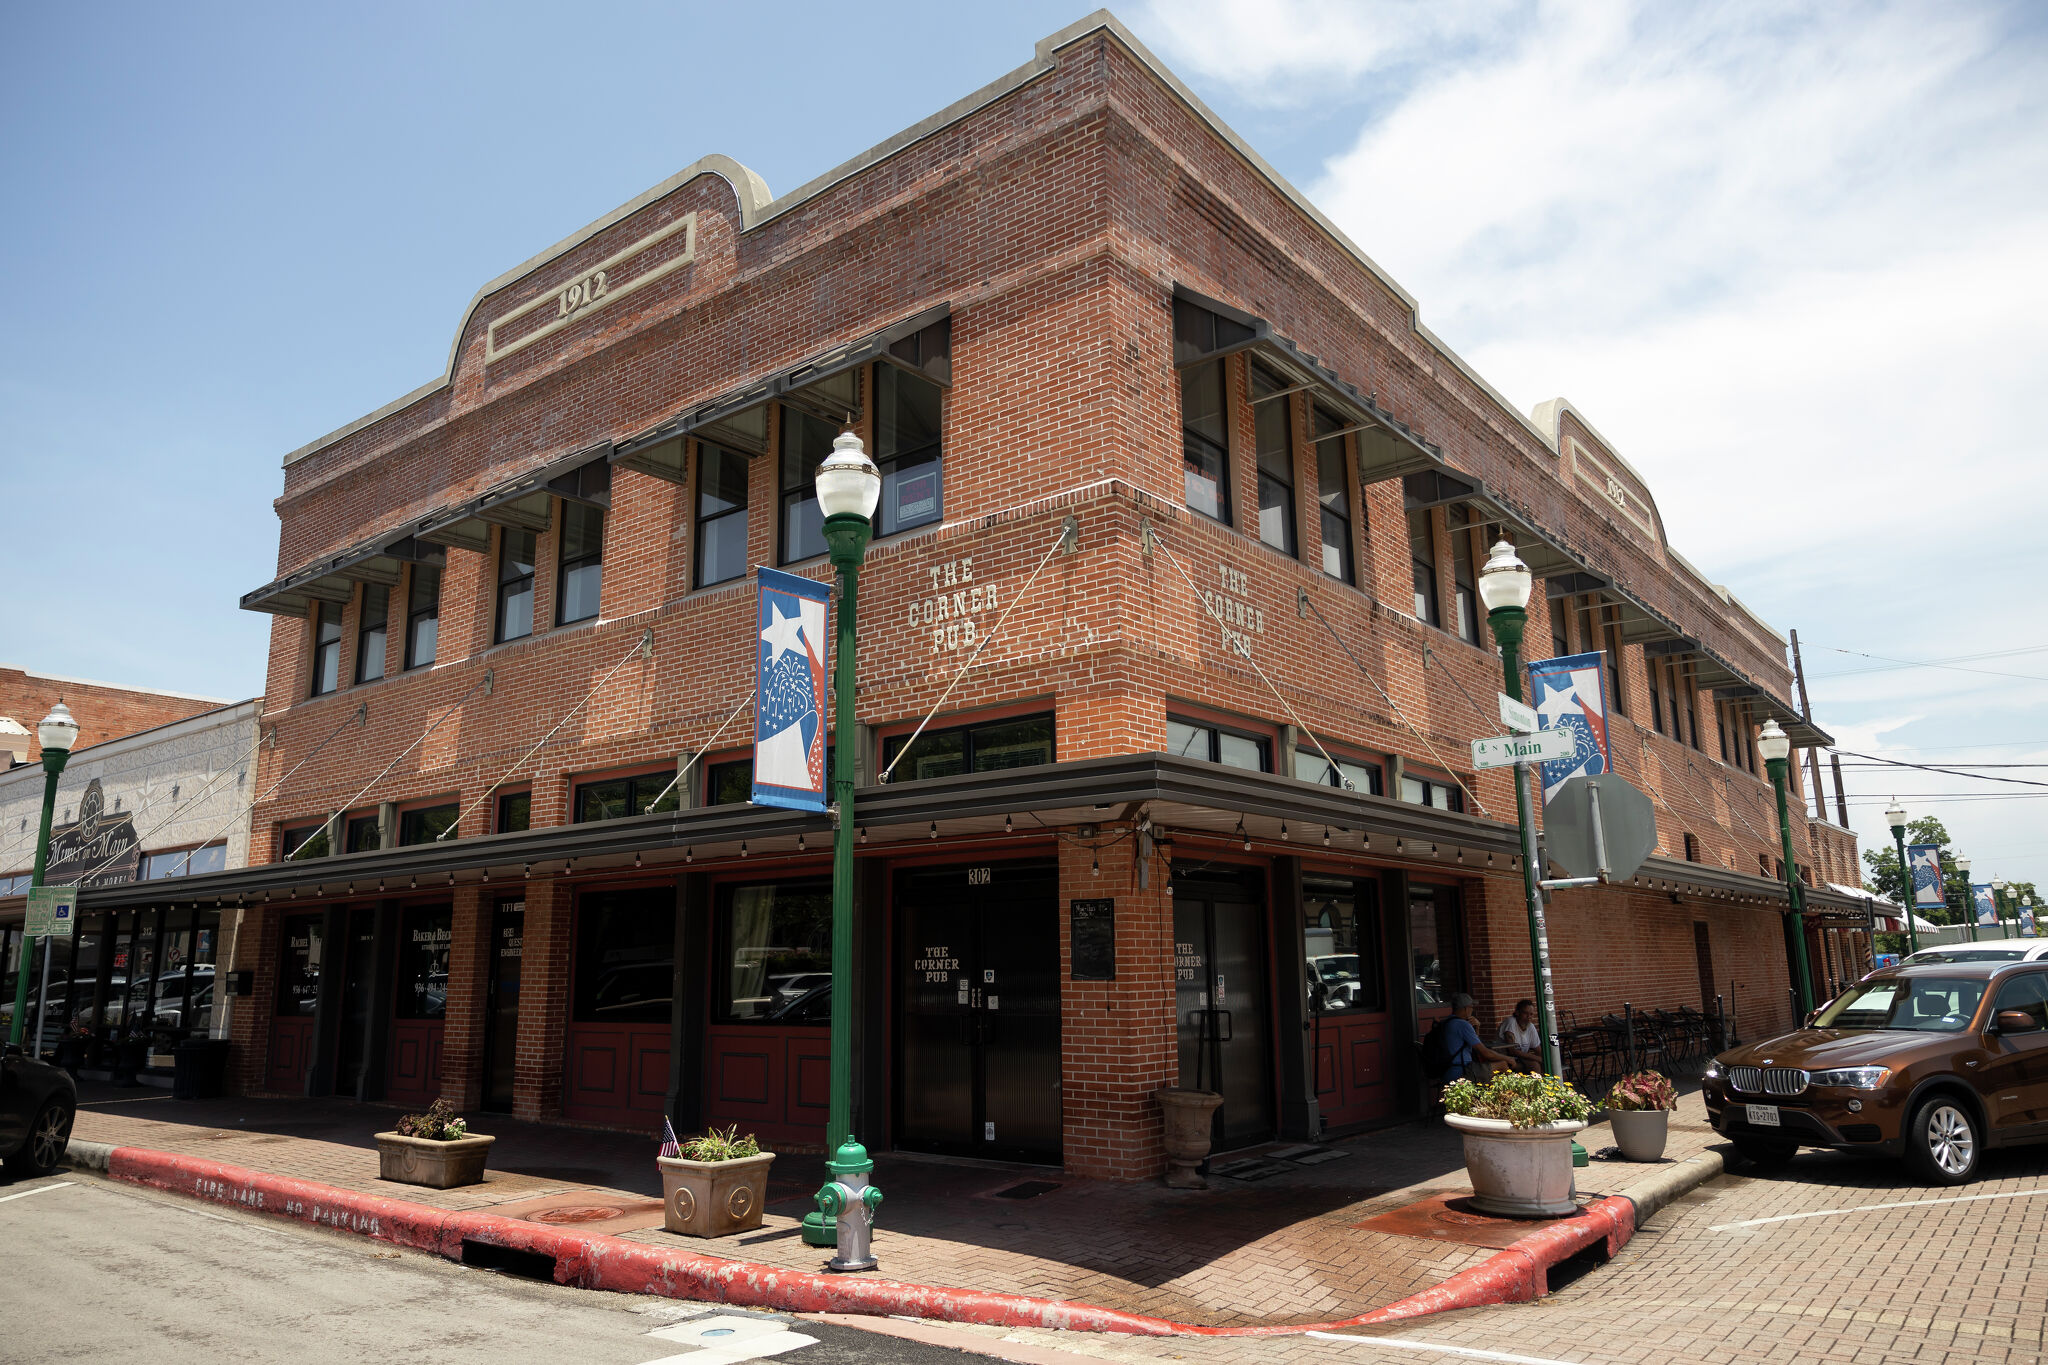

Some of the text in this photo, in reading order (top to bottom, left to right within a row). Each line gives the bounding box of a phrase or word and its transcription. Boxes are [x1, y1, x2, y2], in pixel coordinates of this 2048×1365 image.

[557, 271, 608, 319] 1912
[1606, 477, 1626, 507] 1912
[928, 557, 971, 590] THE
[1218, 564, 1247, 597] THE
[908, 584, 997, 628] CORNER
[1203, 591, 1263, 634] CORNER
[931, 621, 975, 654] PUB
[1220, 631, 1252, 657] PUB
[1558, 731, 1567, 739] St
[1504, 741, 1542, 758] Main
[46, 836, 83, 866] Mimi's
[91, 828, 129, 859] Main
[969, 868, 990, 885] 302
[926, 946, 948, 958] THE
[1176, 943, 1193, 955] THE
[914, 958, 960, 970] CORNER
[925, 970, 948, 983] PUB
[1177, 968, 1194, 980] PUB
[195, 1178, 380, 1237] FIRE LANE NO PARKING
